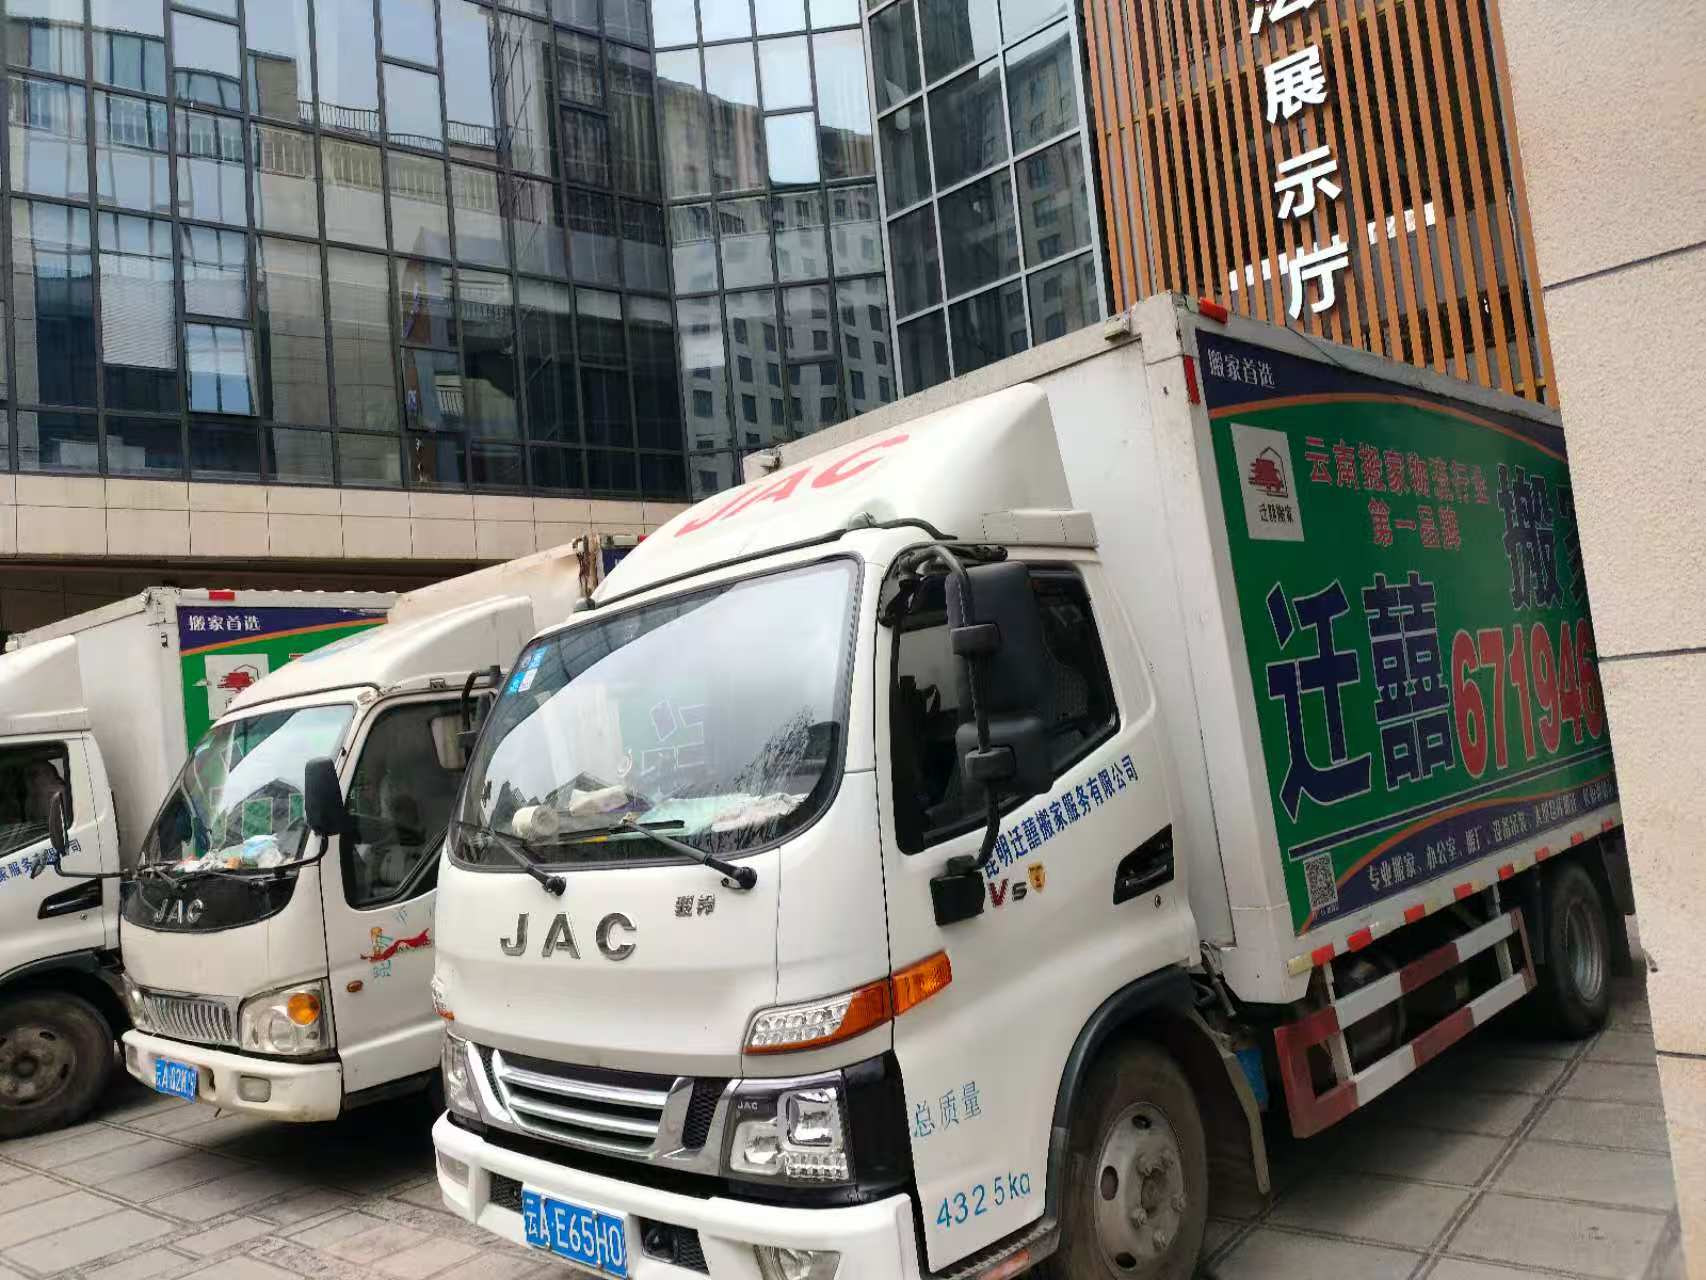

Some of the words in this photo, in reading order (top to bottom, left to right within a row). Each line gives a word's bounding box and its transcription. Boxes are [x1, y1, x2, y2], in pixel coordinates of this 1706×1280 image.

[1207, 348, 1277, 389] 搬家首选
[674, 435, 910, 537] JAC
[189, 615, 262, 631] 搬家首选
[153, 898, 204, 924] JAC
[500, 911, 638, 961] JAC
[914, 1081, 982, 1137] 总质量
